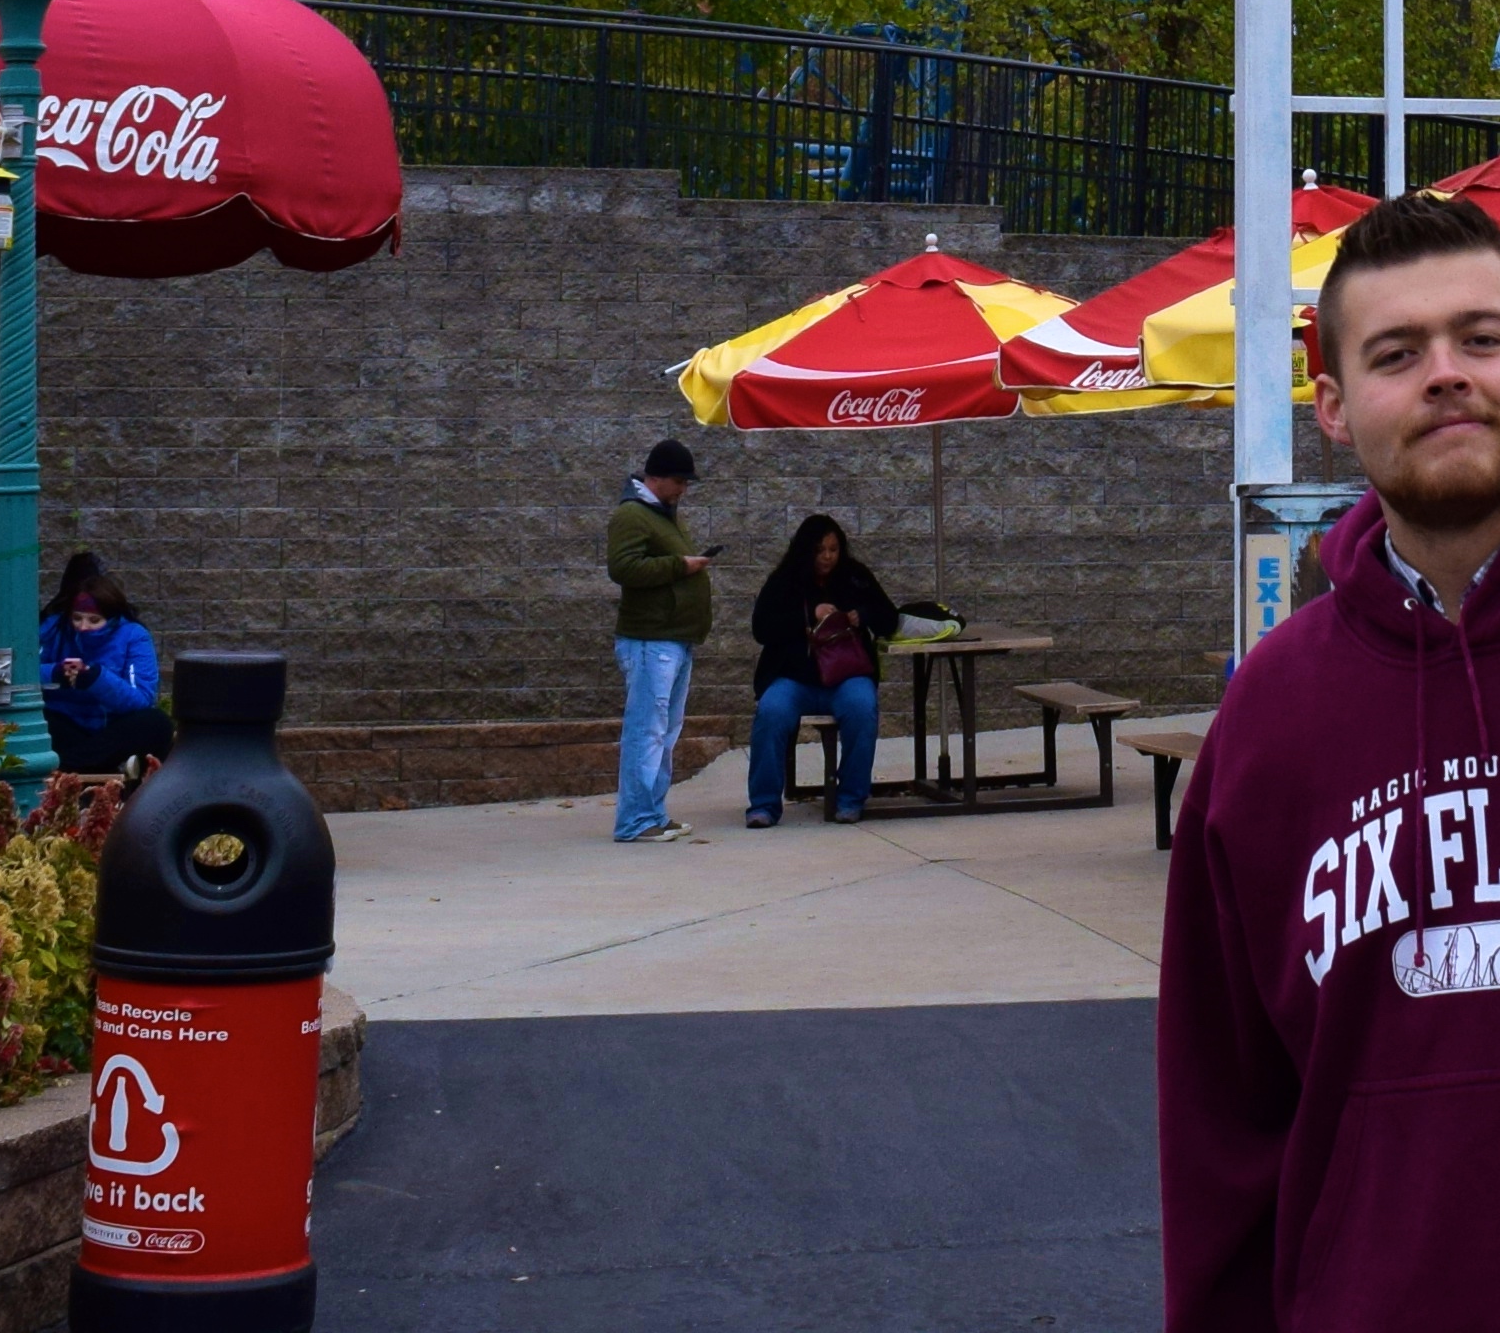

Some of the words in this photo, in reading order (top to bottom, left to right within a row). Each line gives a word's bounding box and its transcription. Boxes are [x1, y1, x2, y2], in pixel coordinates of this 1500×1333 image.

[826, 387, 928, 424] Coca-Cola
[1255, 556, 1283, 637] EXI
[1303, 808, 1410, 987] SIX
[121, 1003, 192, 1023] Recycle
[102, 1021, 124, 1036] and
[127, 1023, 174, 1041] Cans
[178, 1027, 229, 1042] Here
[109, 1181, 127, 1208] it
[134, 1183, 205, 1213] back
[144, 1232, 195, 1250] Coca-Cola
